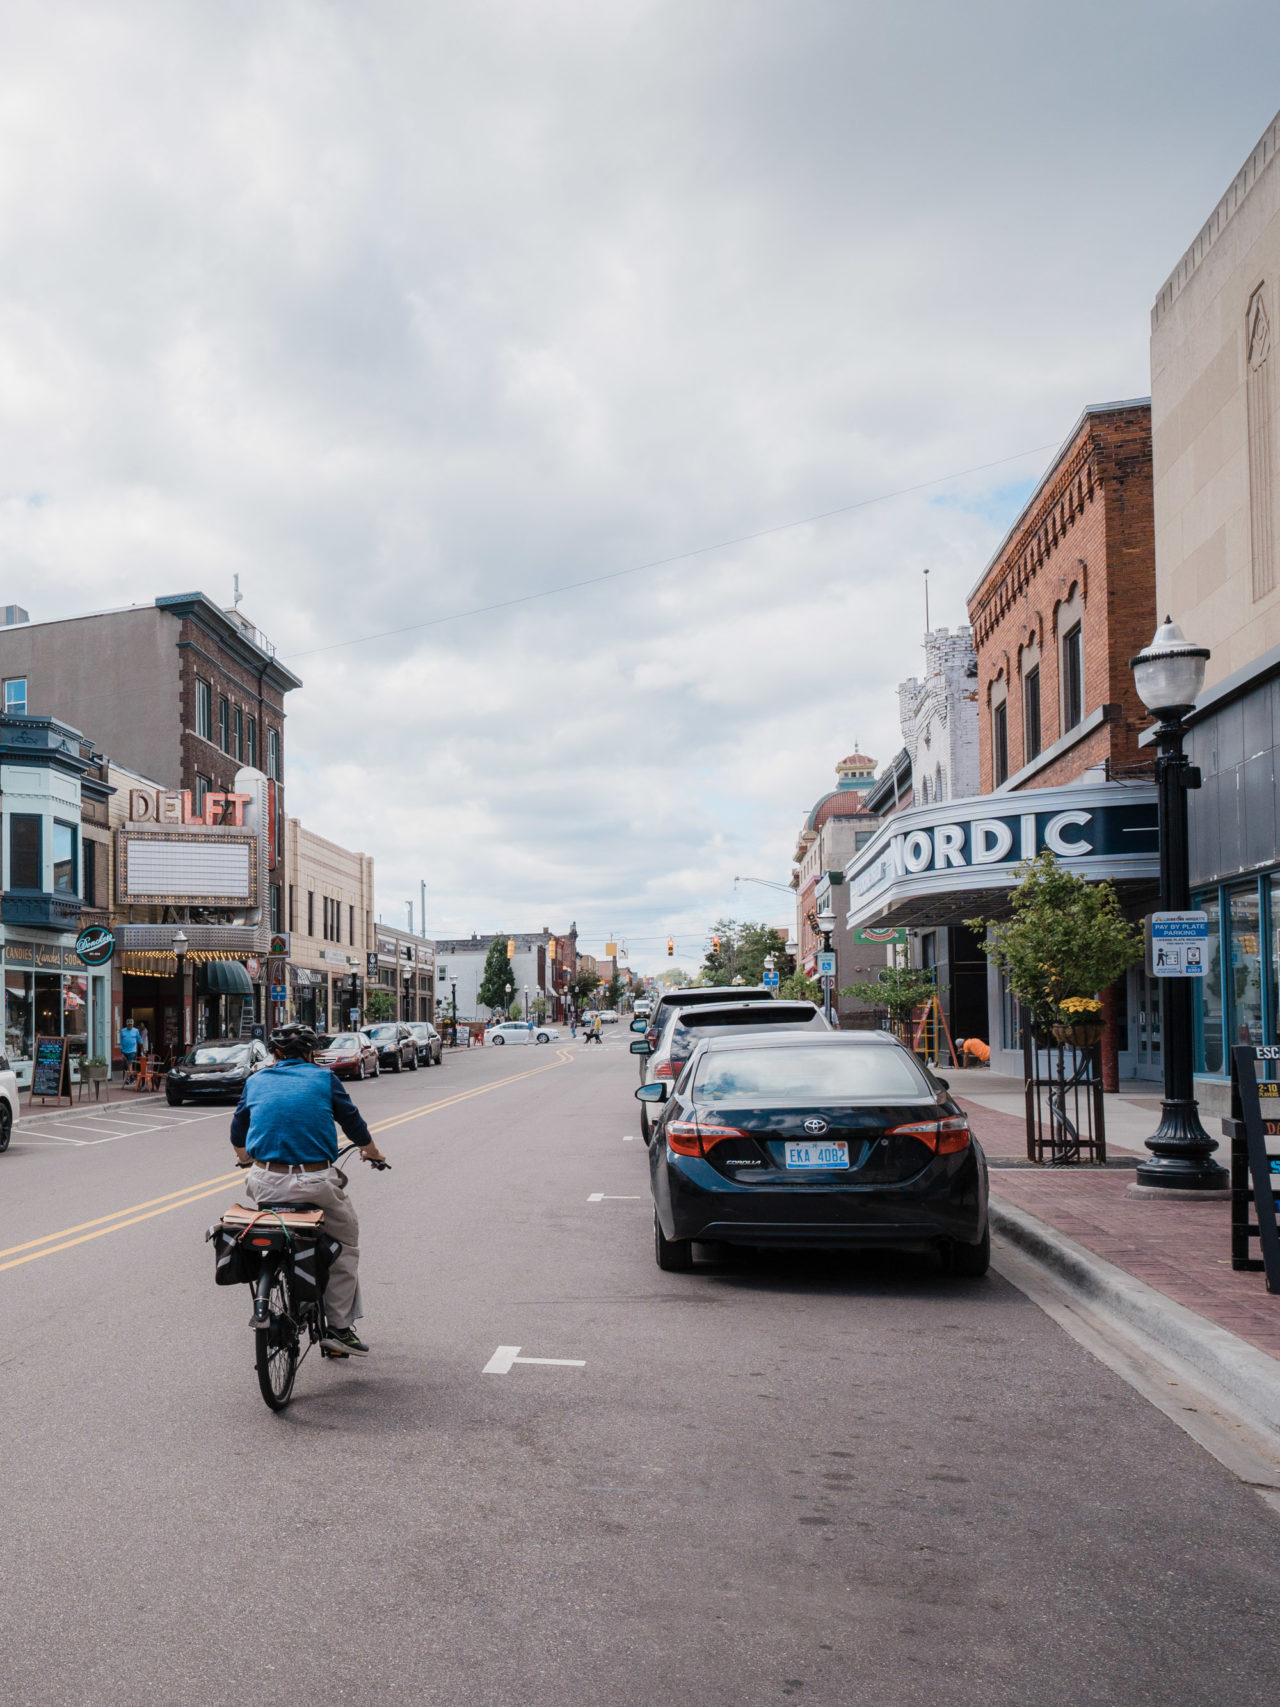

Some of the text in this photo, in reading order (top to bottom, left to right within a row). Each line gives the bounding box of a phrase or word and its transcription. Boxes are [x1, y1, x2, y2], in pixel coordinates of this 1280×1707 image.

[129, 789, 250, 827] DELFT
[889, 810, 1094, 877] NORDIC
[5, 945, 33, 961] CANDIES
[1255, 1047, 1280, 1060] ESC
[1258, 1083, 1278, 1093] 2-10
[789, 1148, 846, 1163] EKA 4082
